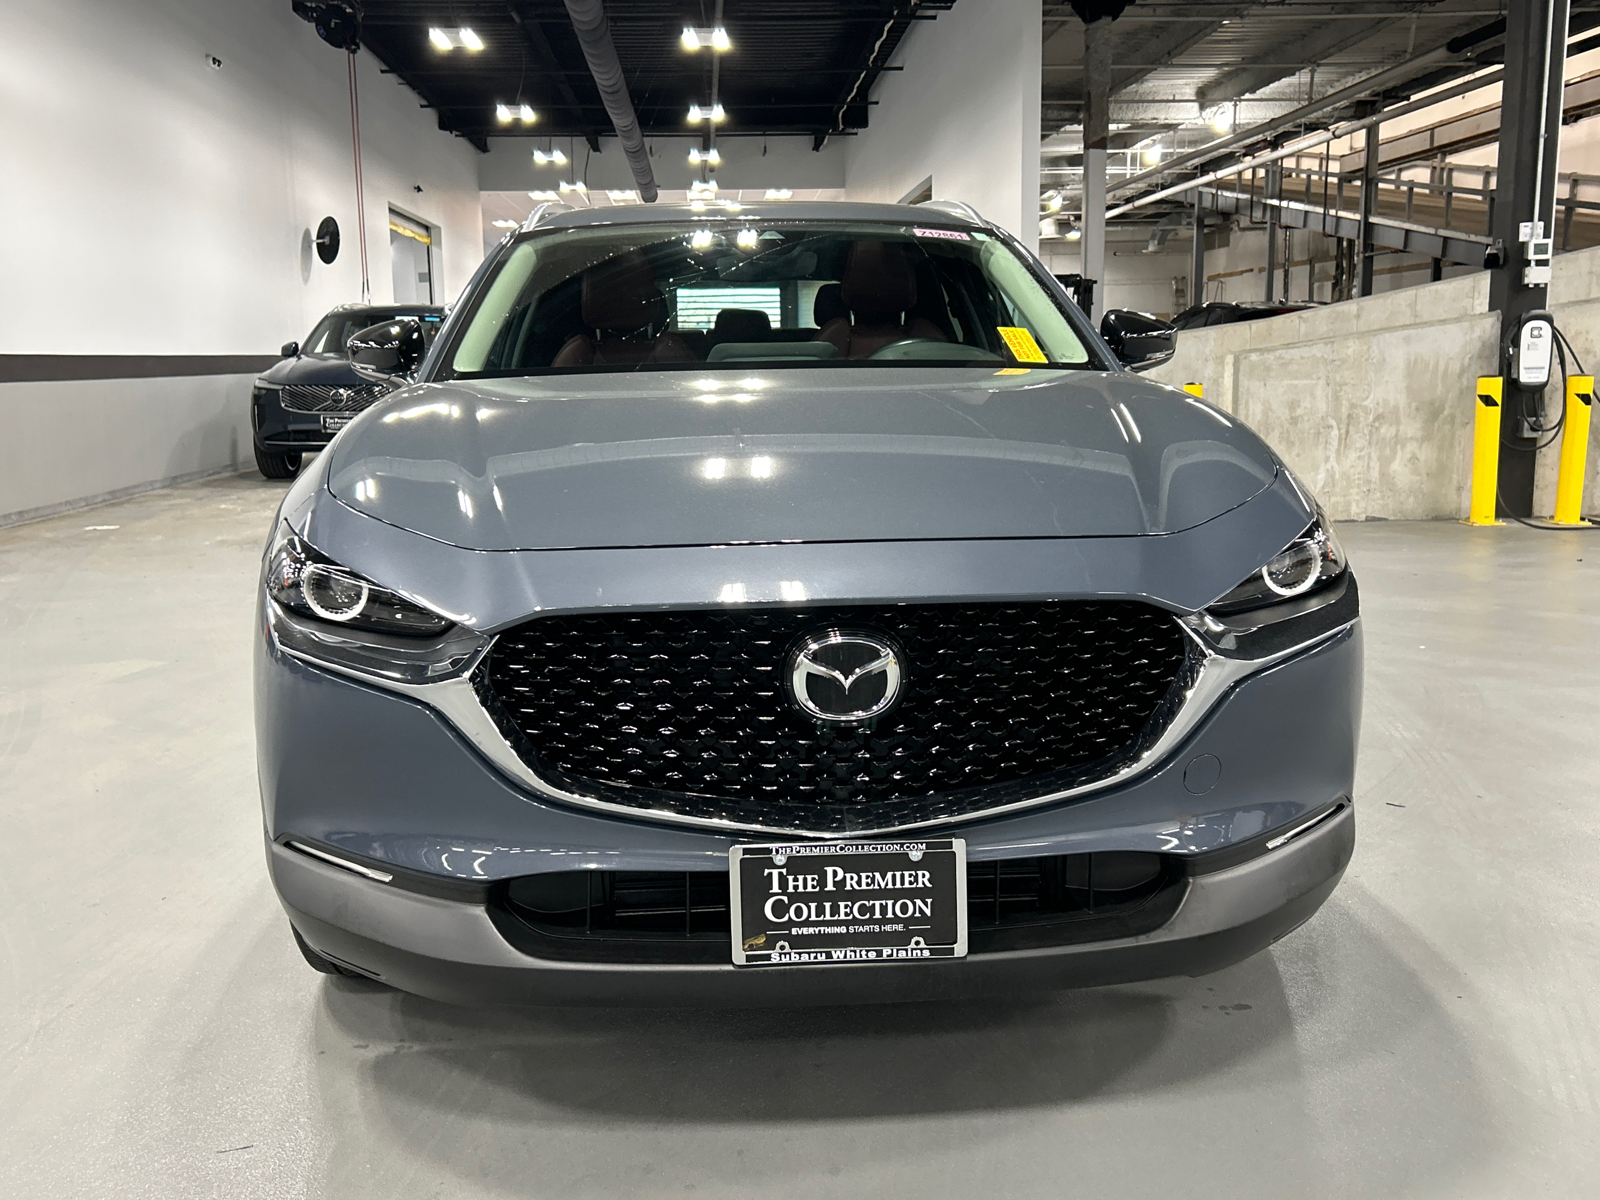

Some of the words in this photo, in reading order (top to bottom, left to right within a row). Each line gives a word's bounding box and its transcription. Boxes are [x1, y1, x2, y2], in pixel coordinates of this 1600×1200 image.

[763, 868, 820, 893] THE
[823, 866, 933, 891] PREMIER
[763, 895, 933, 923] COLLECTION
[791, 926, 847, 935] EVERYTHING
[848, 925, 880, 933] STARTS
[881, 923, 906, 932] HERE.
[770, 951, 826, 962] Subaru
[831, 948, 877, 959] White
[882, 948, 931, 957] Plains
